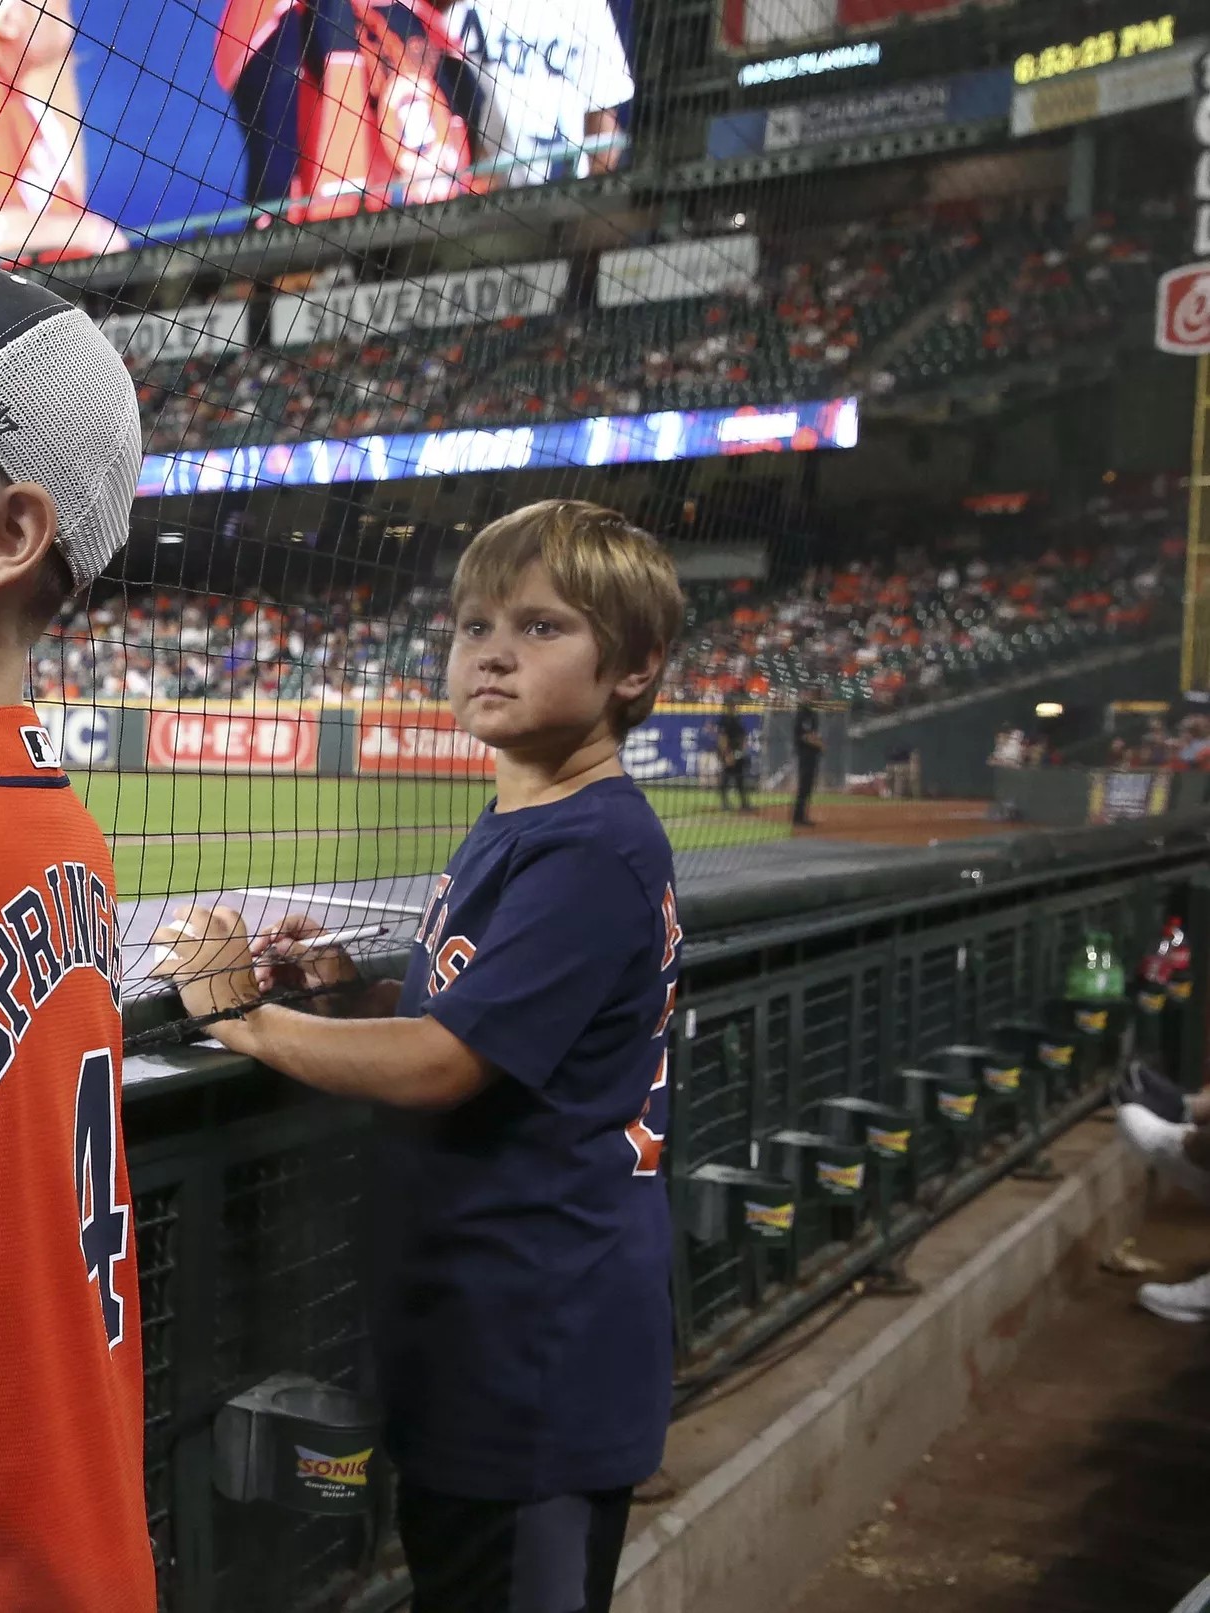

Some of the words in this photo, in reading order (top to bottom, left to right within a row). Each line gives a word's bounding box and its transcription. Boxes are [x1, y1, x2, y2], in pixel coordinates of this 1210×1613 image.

[306, 274, 531, 337] SILVERADO
[169, 718, 294, 757] H-E-B
[73, 1046, 129, 1360] 4
[299, 1457, 368, 1478] SONIC
